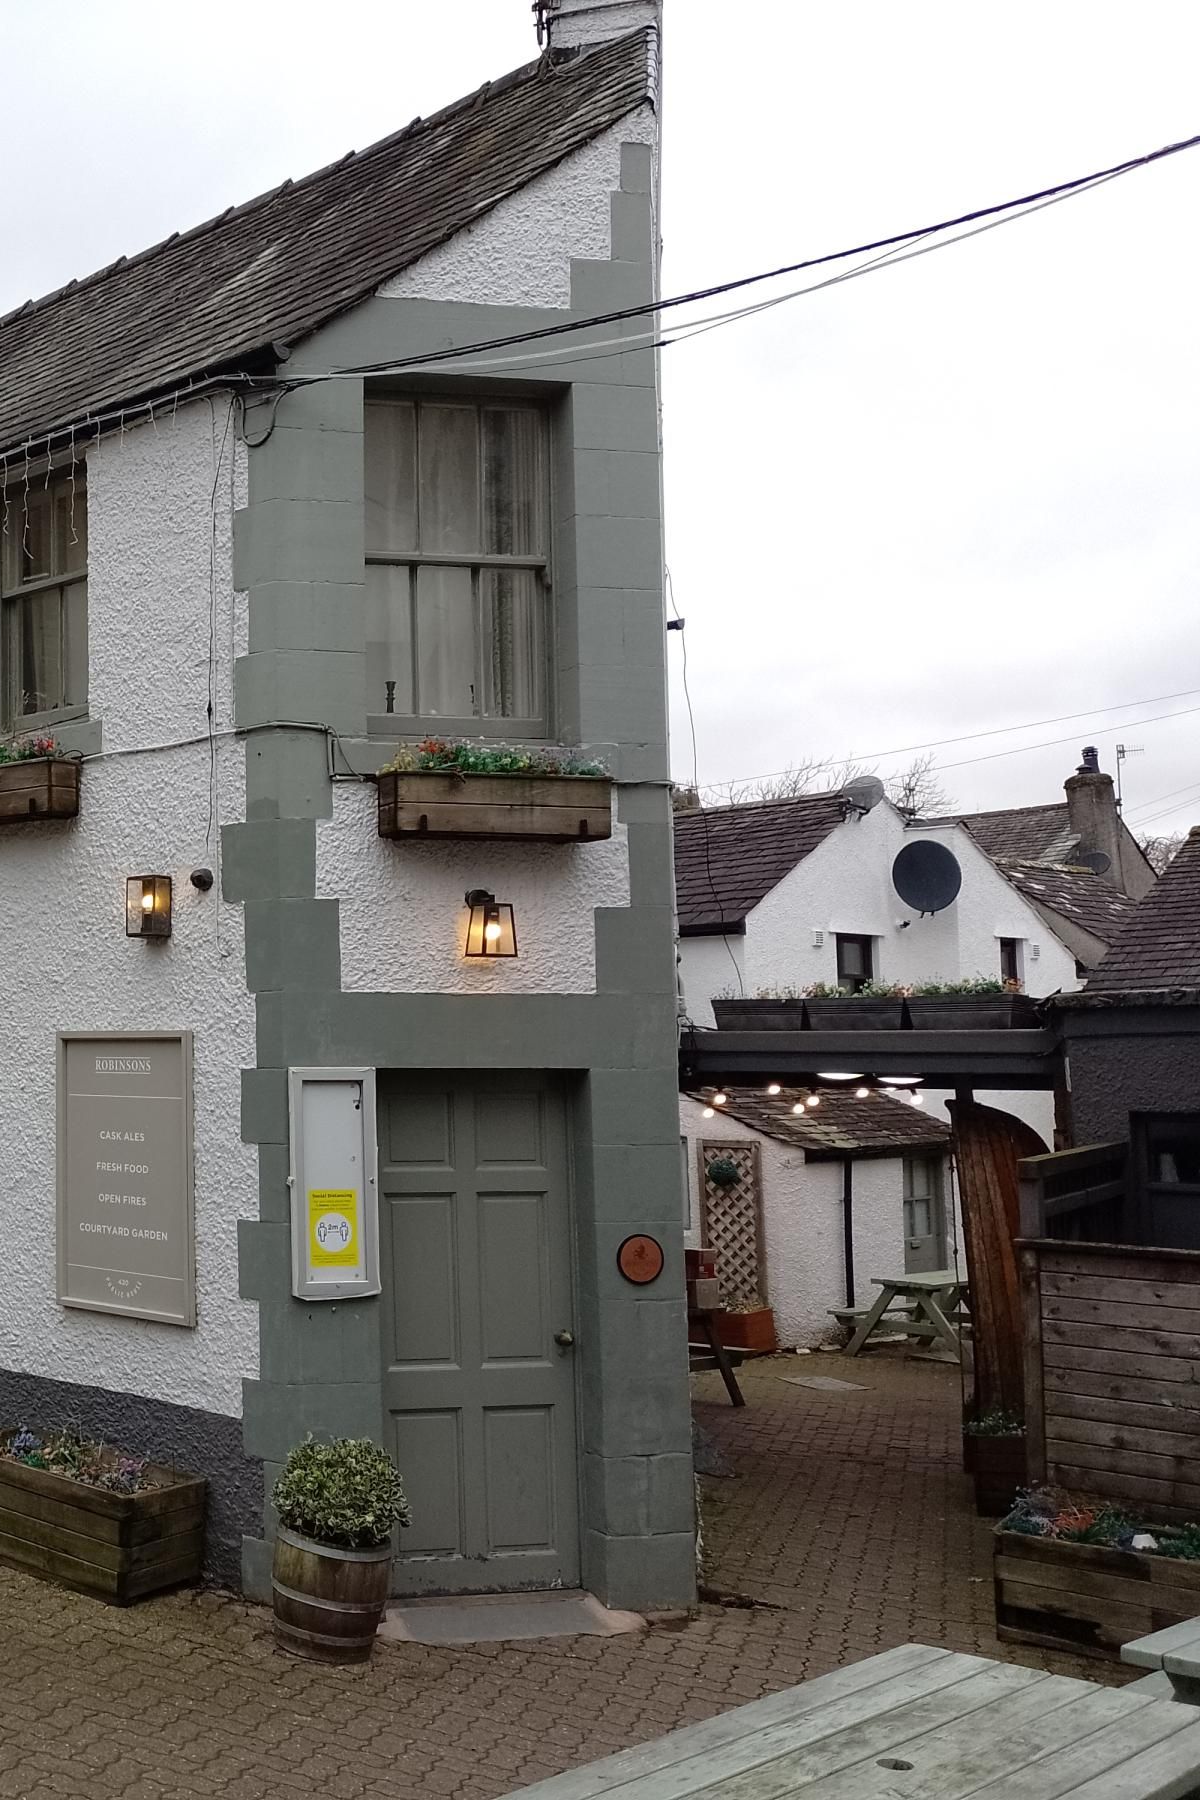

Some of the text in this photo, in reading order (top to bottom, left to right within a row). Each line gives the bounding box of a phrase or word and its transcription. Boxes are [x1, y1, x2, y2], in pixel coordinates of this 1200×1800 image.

[95, 1059, 151, 1071] ROBINSONS
[100, 1130, 145, 1142] CASK ALES
[96, 1161, 149, 1174] FRESH FOOD
[98, 1193, 147, 1206] OPEN FIRES
[79, 1222, 168, 1241] COURTYARD GARDEN
